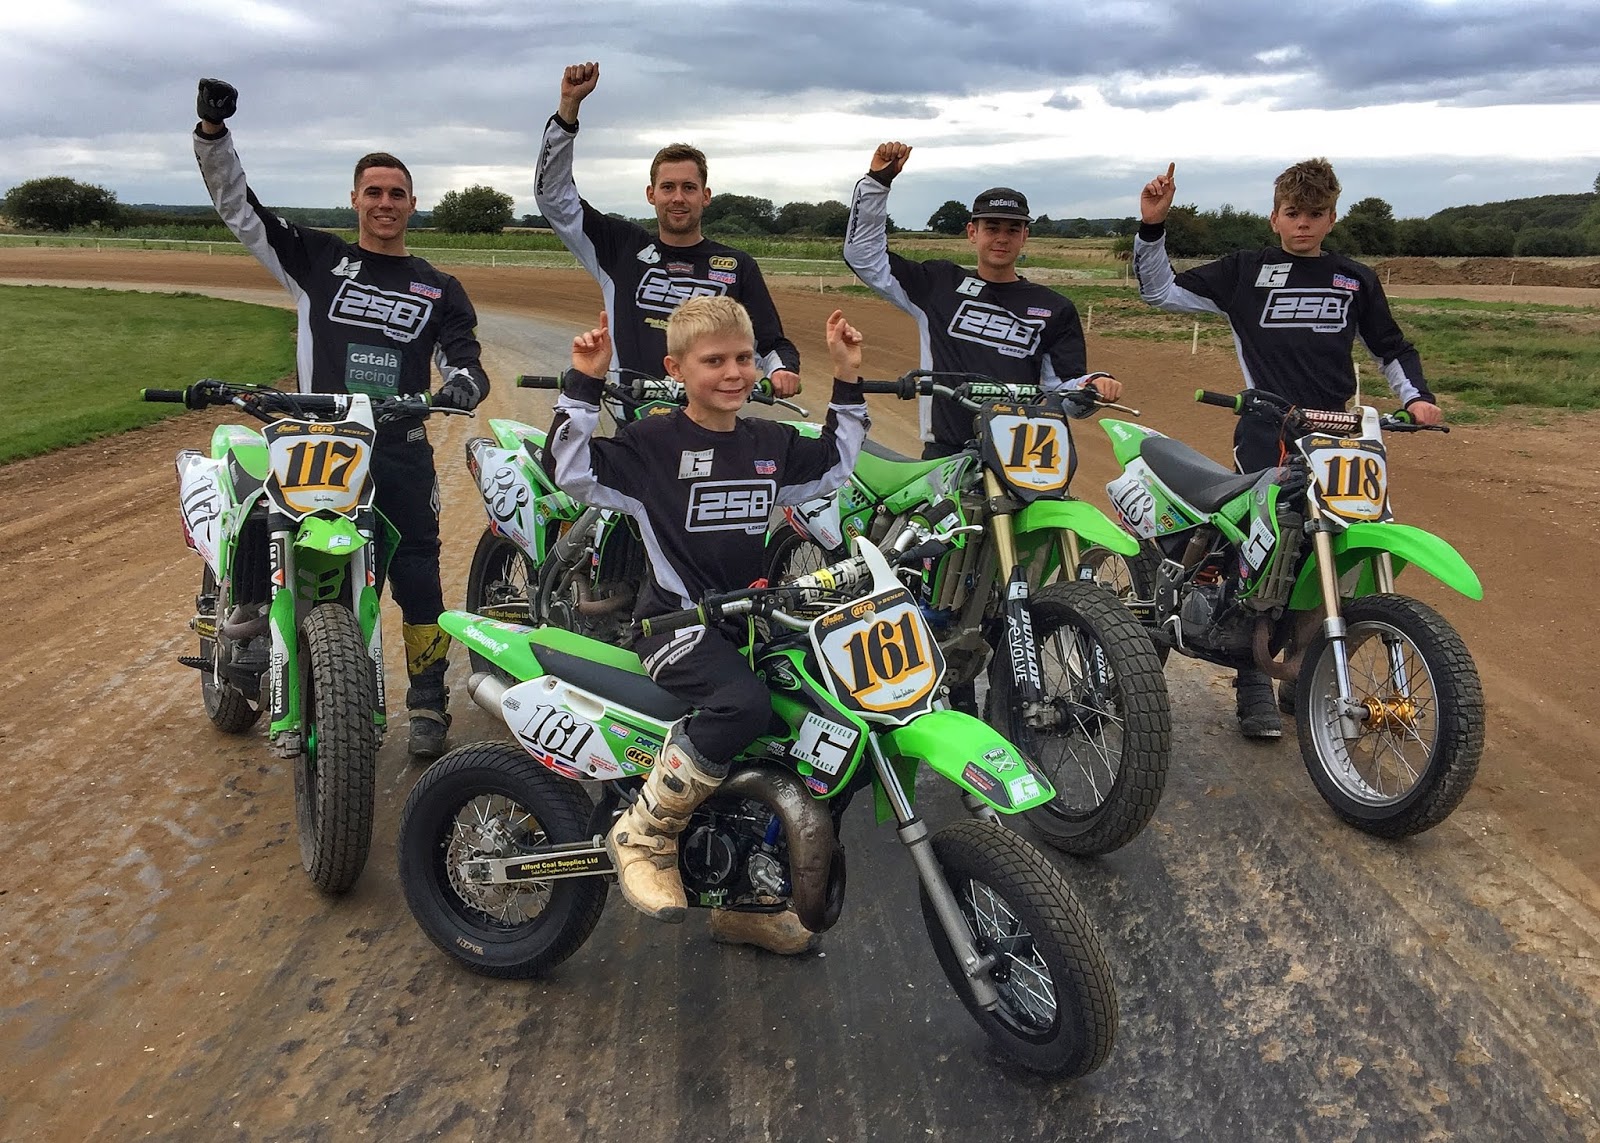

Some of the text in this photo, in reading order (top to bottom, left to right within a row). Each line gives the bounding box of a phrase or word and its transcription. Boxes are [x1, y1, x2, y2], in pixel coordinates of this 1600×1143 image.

[349, 368, 396, 386] racing
[350, 352, 398, 368] català
[1305, 412, 1358, 424] RENTHAL
[281, 440, 361, 491] 117
[1005, 423, 1058, 472] 14
[1322, 456, 1382, 502] 118
[1114, 480, 1153, 526] 118
[842, 612, 928, 695] 161
[1020, 608, 1041, 690] DUNLOP
[274, 652, 283, 714] Kawasaki
[374, 648, 384, 707] Kawasaki
[518, 704, 594, 763] 161
[808, 715, 854, 740] GREENFIELD
[626, 750, 654, 766] dtra
[793, 748, 834, 773] DIRT TRACK
[521, 863, 540, 871] Alford
[557, 858, 586, 868] Supplies
[587, 857, 599, 865] Ltd
